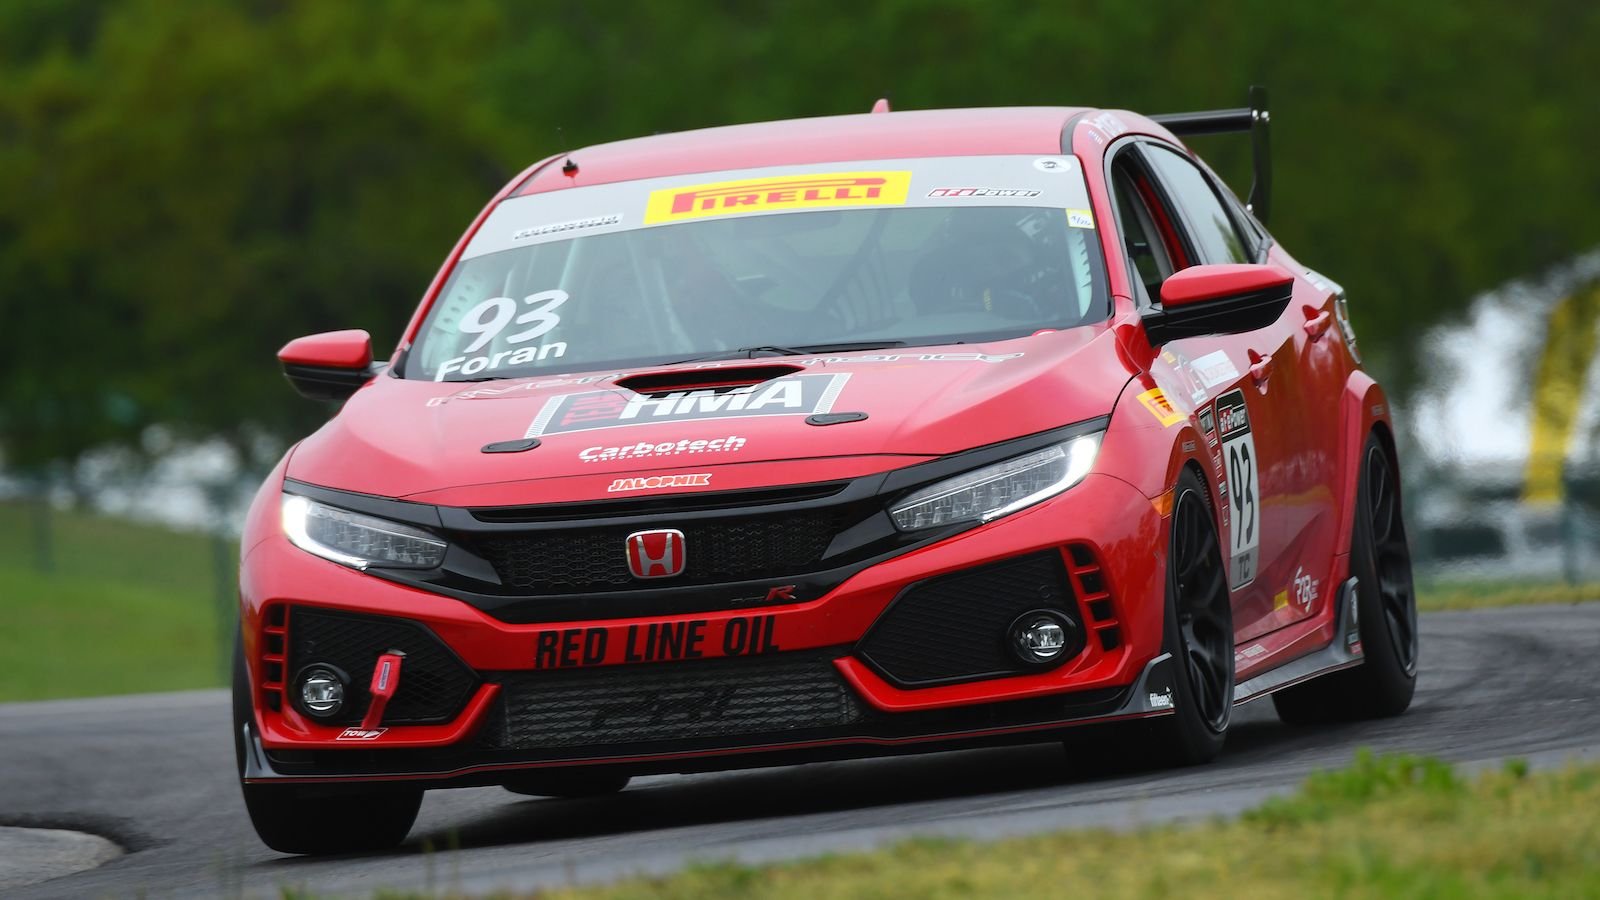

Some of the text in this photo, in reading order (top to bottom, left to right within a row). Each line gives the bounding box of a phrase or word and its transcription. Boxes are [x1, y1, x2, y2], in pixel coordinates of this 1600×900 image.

[671, 177, 887, 214] PIRELLI
[460, 289, 569, 353] 93
[434, 342, 567, 382] Foran
[618, 381, 802, 419] HMA
[578, 436, 747, 460] Carbotech
[608, 474, 712, 492] JALOPNIK
[1230, 442, 1254, 549] 93
[536, 615, 779, 669] RED LINE OIL
